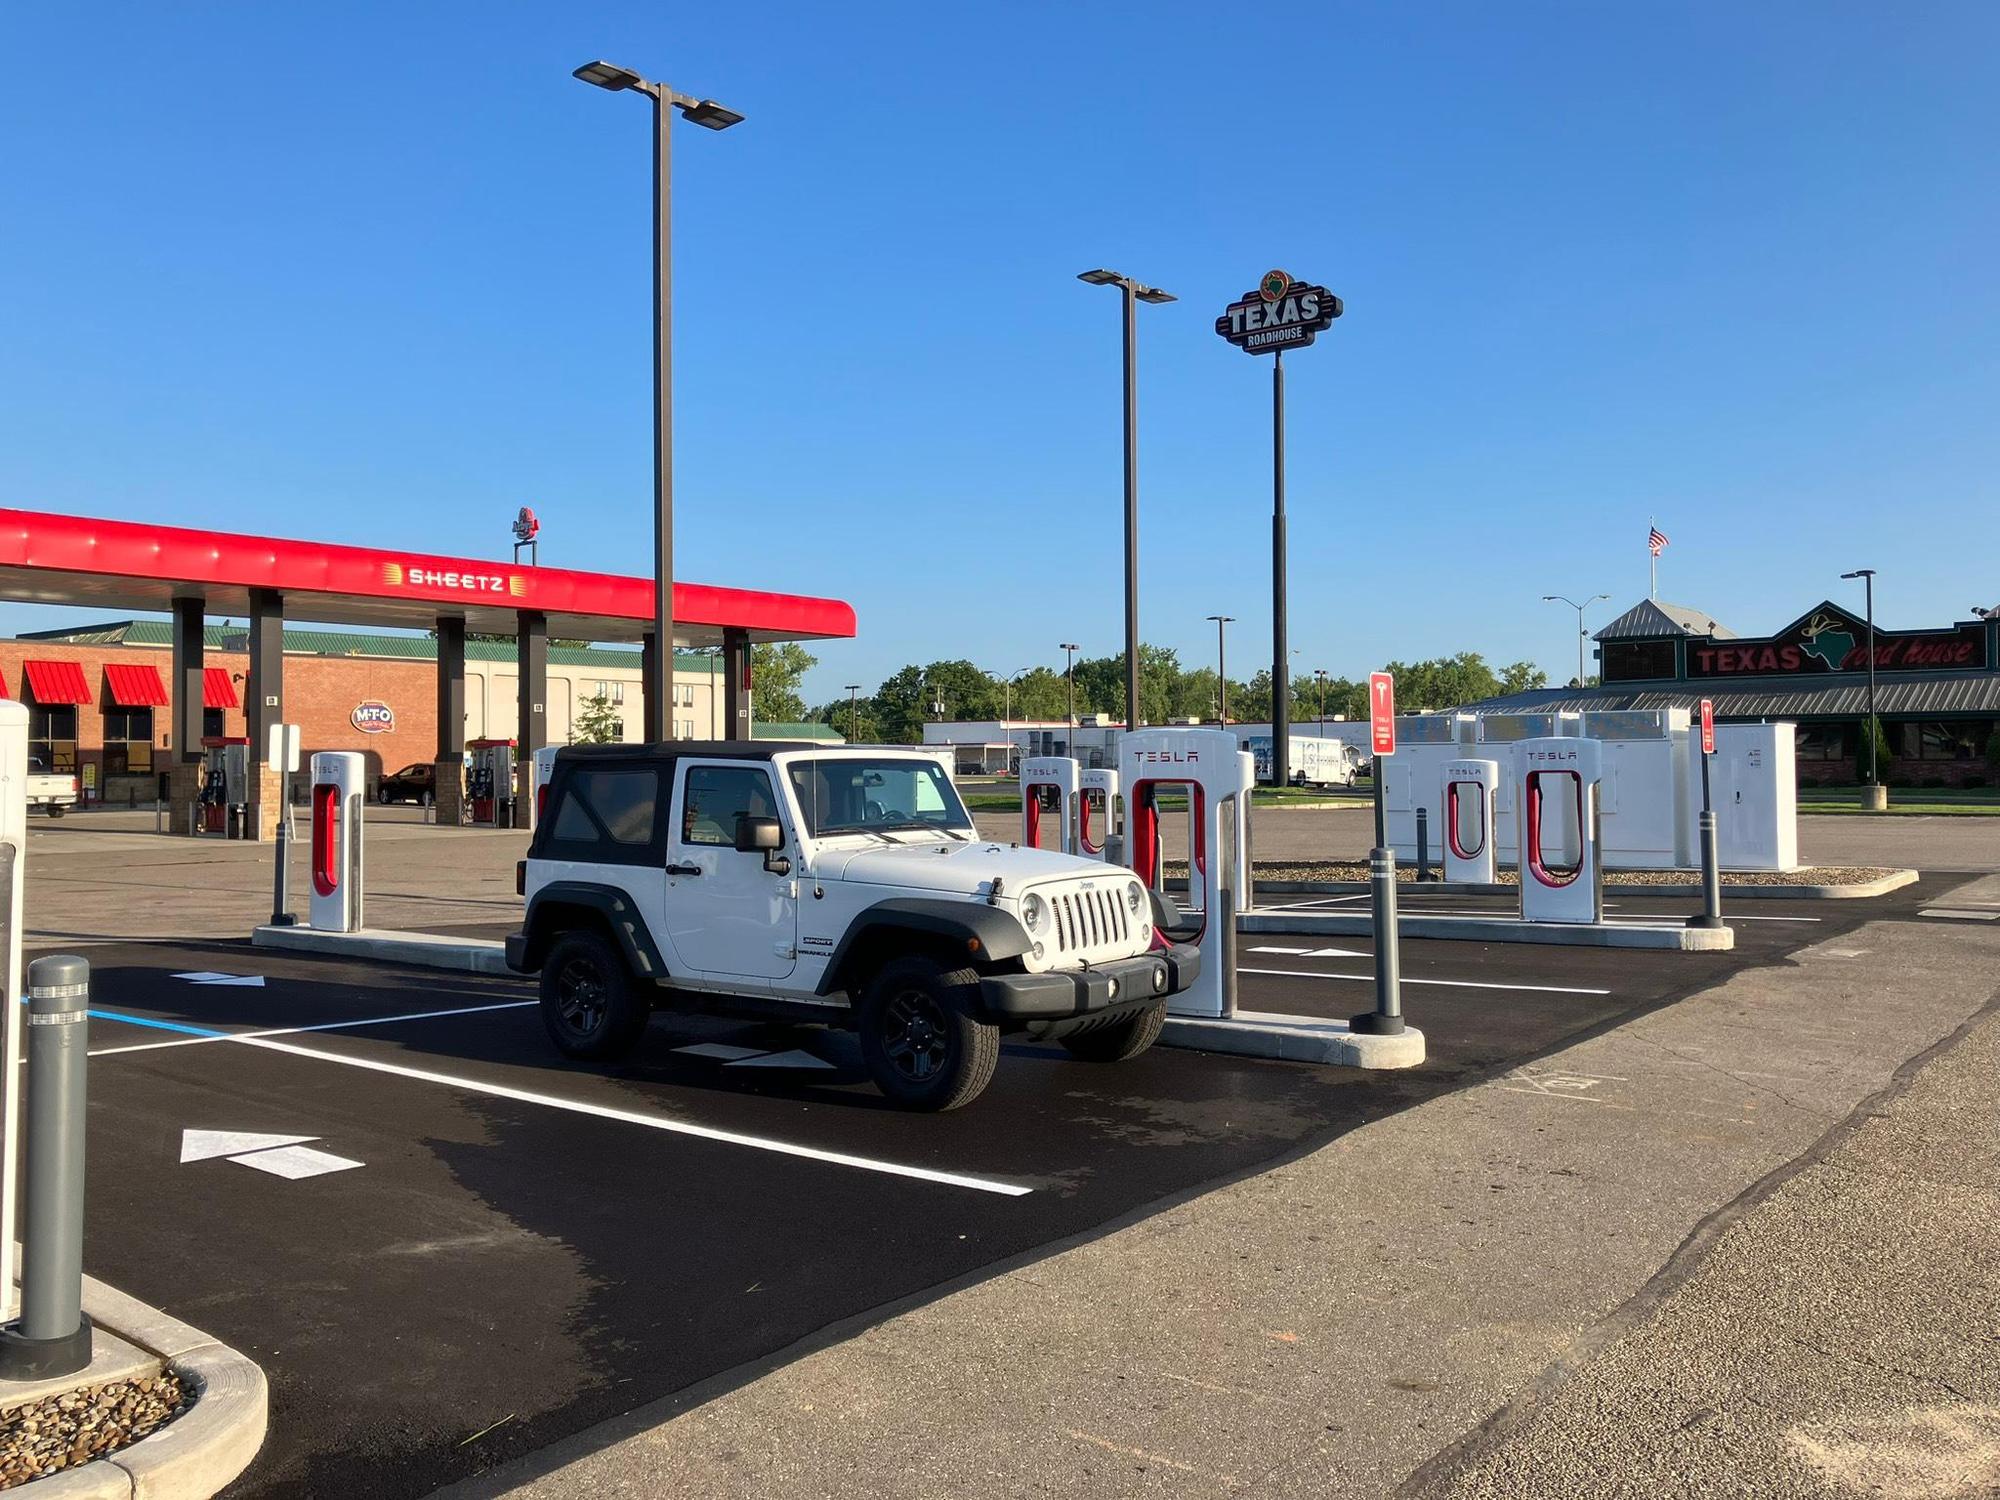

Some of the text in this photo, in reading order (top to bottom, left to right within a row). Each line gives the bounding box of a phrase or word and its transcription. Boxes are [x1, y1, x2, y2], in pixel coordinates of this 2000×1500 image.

[1228, 293, 1319, 333] TEXAS
[1248, 326, 1303, 347] ROADHOUSE
[408, 569, 504, 591] SHEETZ
[1696, 645, 1801, 672] TEXAS
[1902, 640, 1974, 664] house
[1134, 751, 1199, 762] TESLA
[1528, 752, 1577, 760] TESLA
[1027, 768, 1059, 776] TESLA
[1079, 881, 1095, 889] Jeep
[798, 949, 834, 957] WRANGLE
